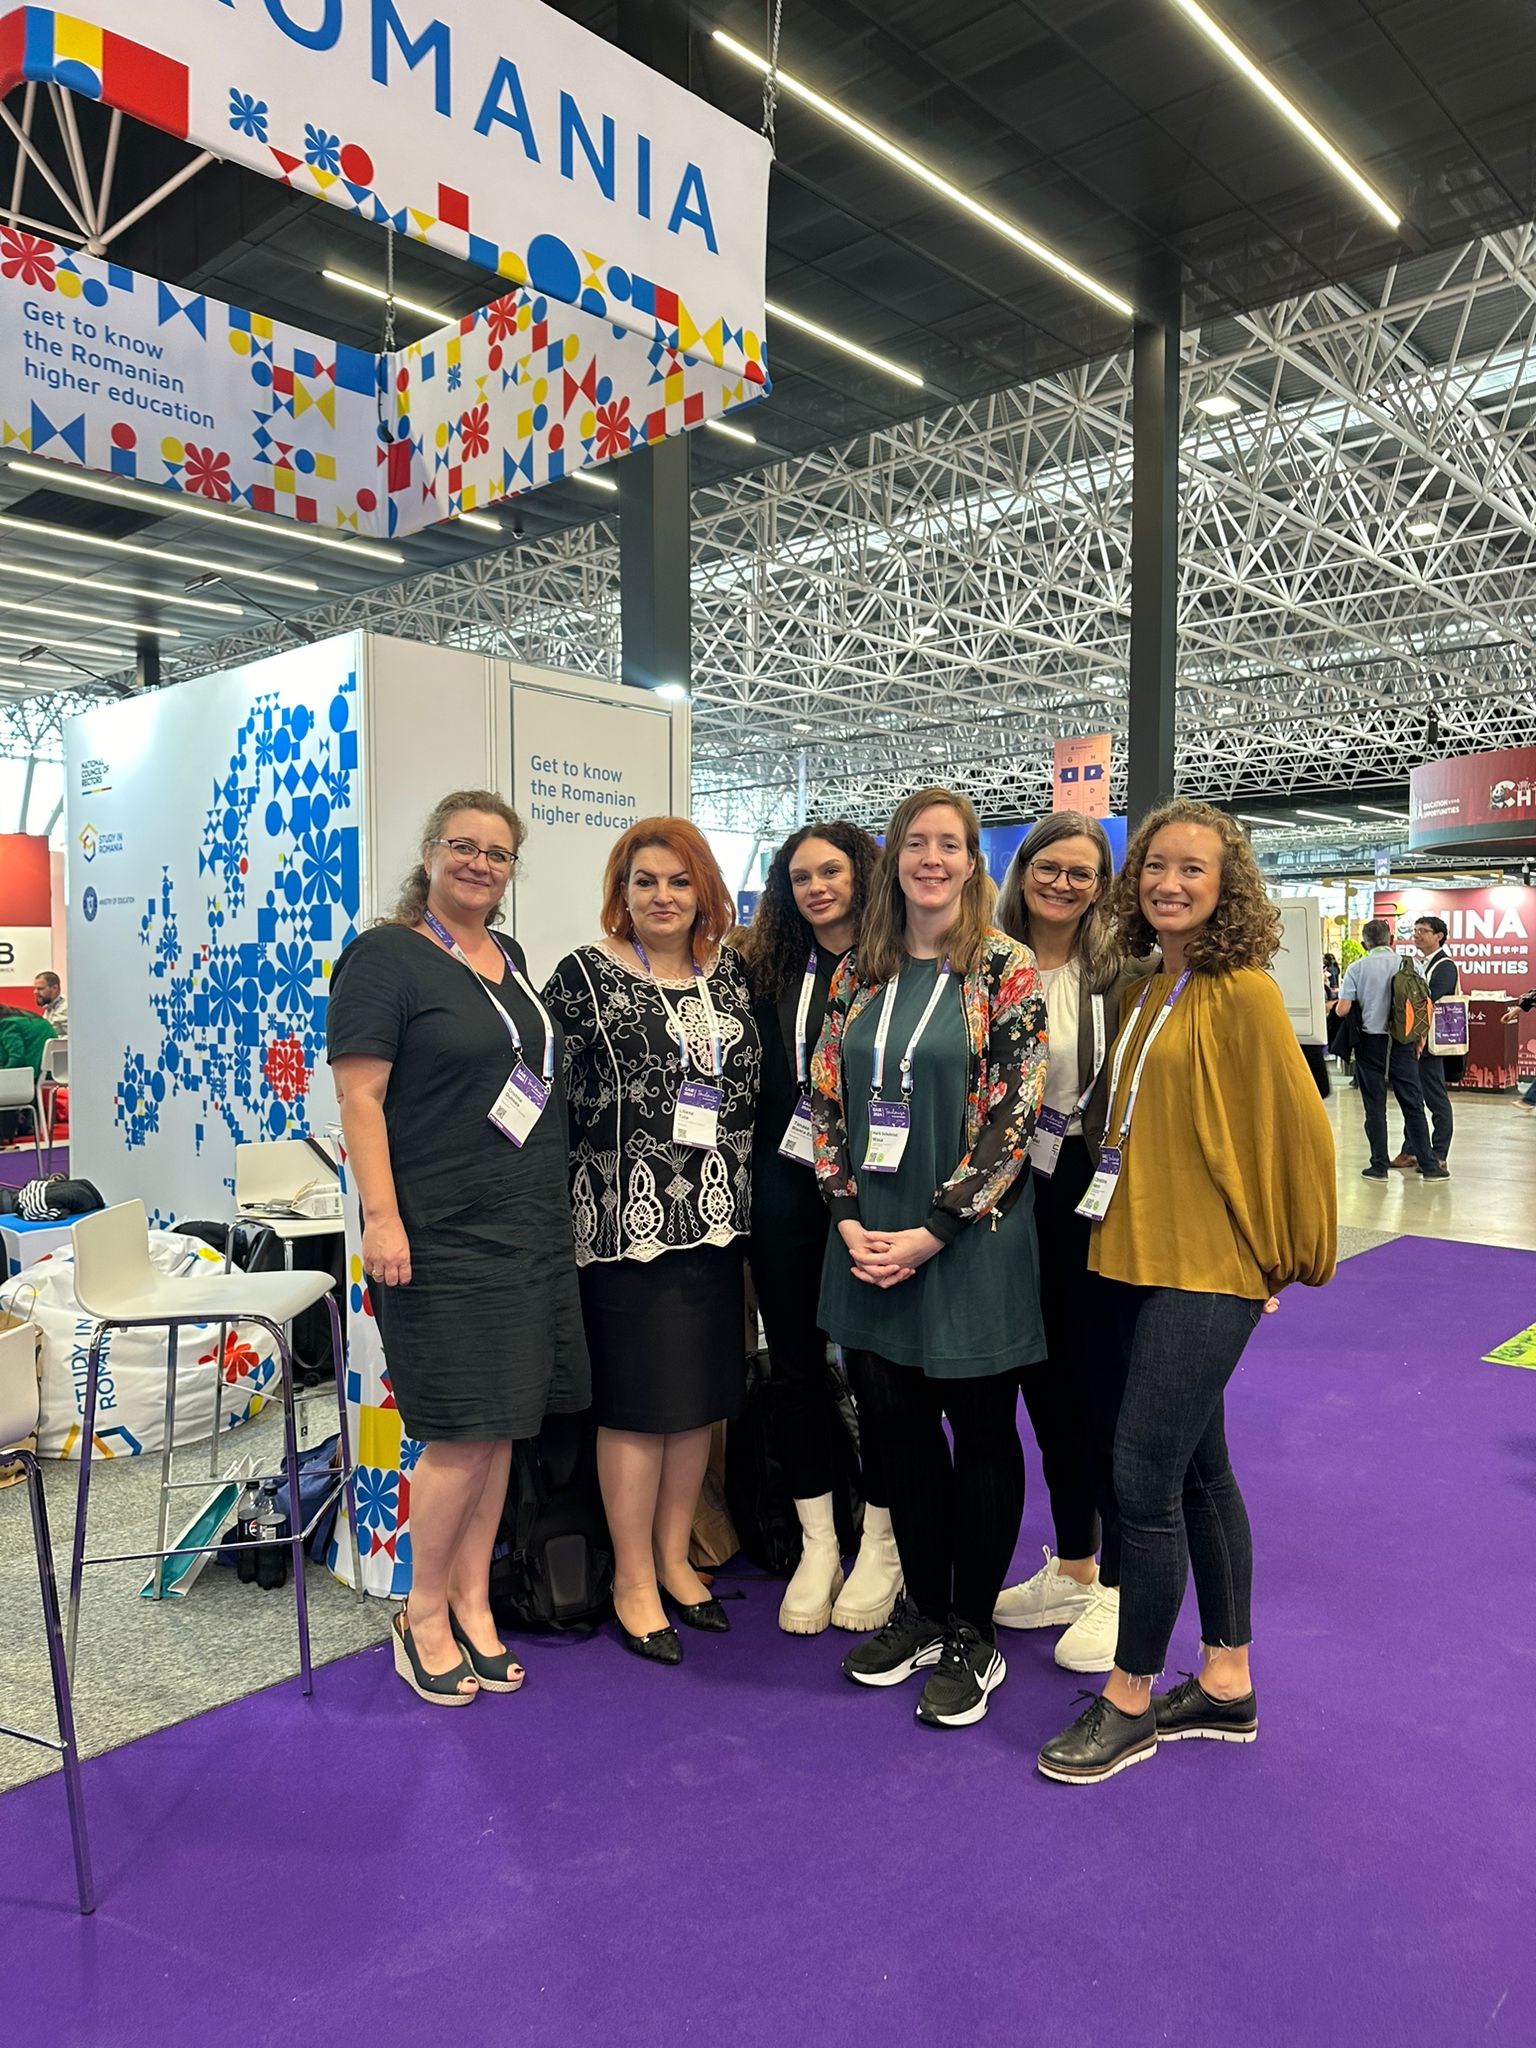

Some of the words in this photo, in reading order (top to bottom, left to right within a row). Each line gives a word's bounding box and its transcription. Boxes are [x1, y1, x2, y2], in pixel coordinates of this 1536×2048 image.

[218, 0, 719, 256] OMANIA
[23, 301, 66, 330] Get
[72, 316, 97, 339] to
[104, 325, 164, 360] know
[23, 329, 63, 357] the
[71, 343, 184, 394] Romanian
[24, 357, 101, 395] higher
[108, 387, 215, 430] education
[103, 764, 110, 774] OF
[531, 755, 558, 774] Get
[563, 760, 579, 777] to
[583, 762, 622, 783] know
[531, 780, 557, 798] the
[562, 783, 636, 808] Romanian
[1491, 779, 1536, 808] CH
[531, 803, 581, 826] higher
[585, 811, 640, 830] educati
[99, 833, 116, 845] STUDY
[99, 843, 123, 854] ROMANIA
[1395, 943, 1491, 957] EDATION
[75, 1318, 93, 1336] IN
[97, 1331, 117, 1410] ROMANI
